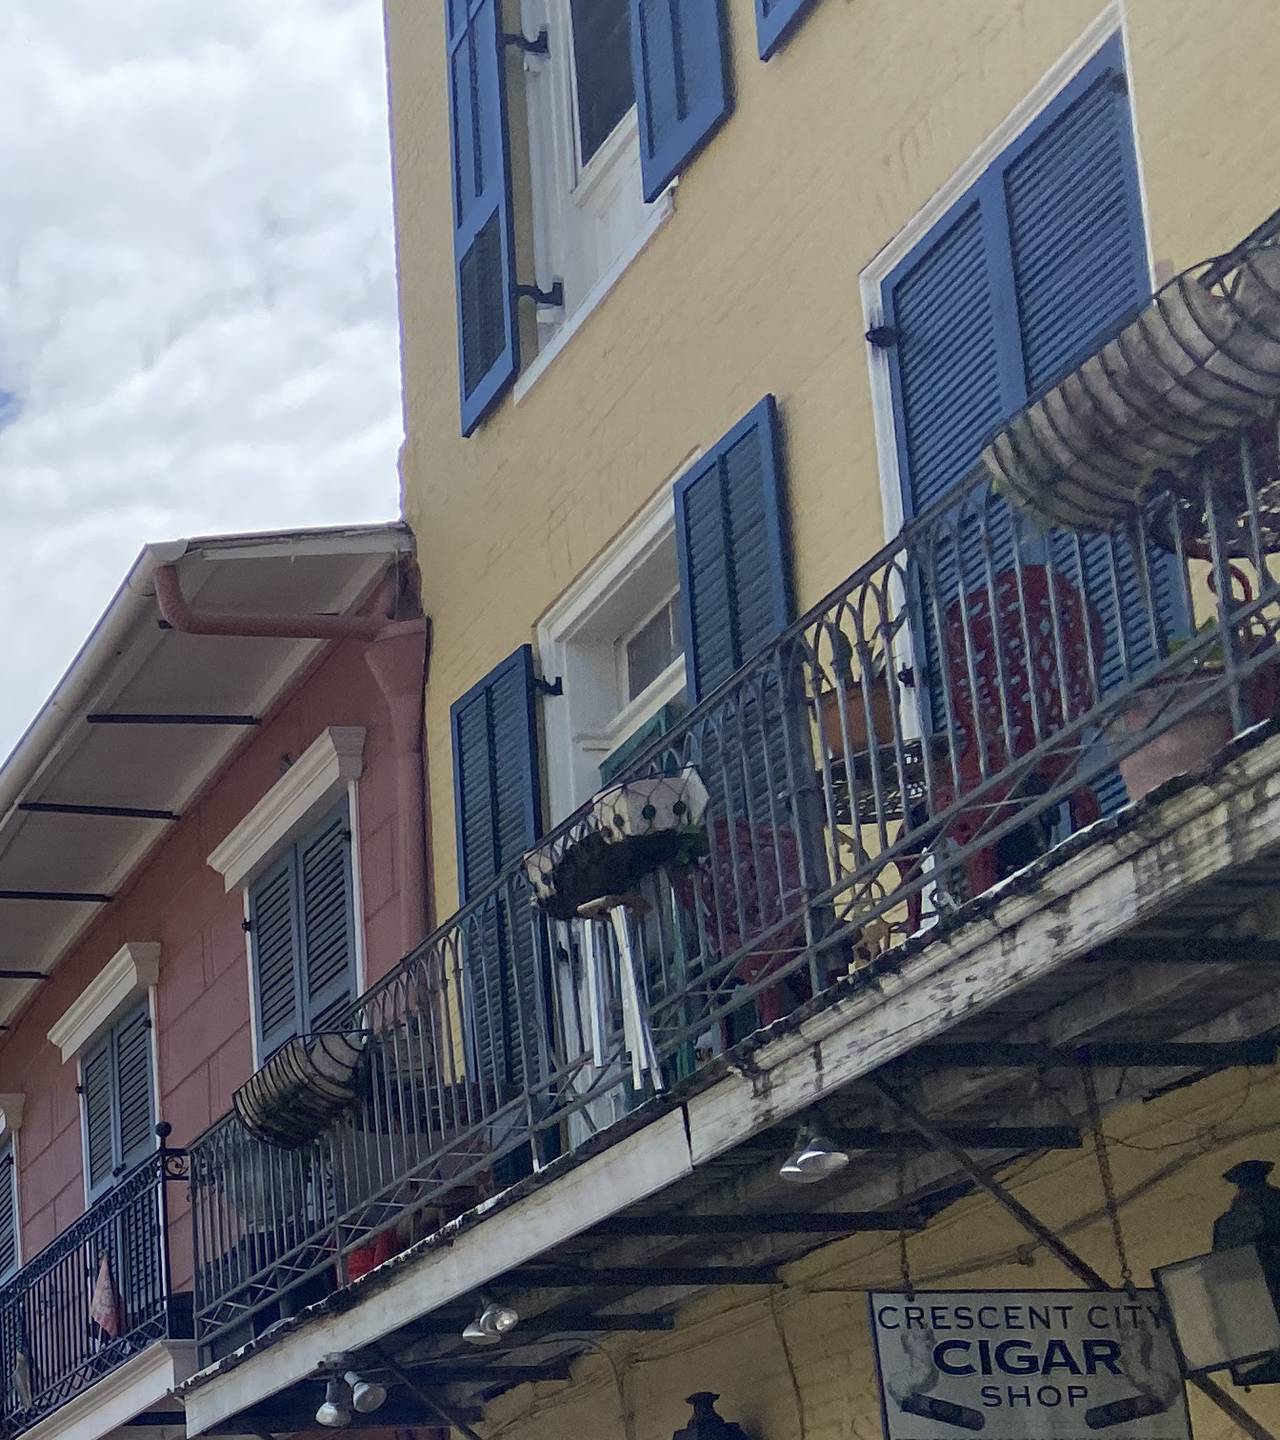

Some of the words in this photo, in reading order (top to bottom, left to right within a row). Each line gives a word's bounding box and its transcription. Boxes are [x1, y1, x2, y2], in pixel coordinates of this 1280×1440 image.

[878, 1306, 1073, 1329] CRESCENT
[1087, 1306, 1163, 1329] CITY
[933, 1339, 1123, 1376] CIGAR
[981, 1385, 1088, 1407] SHOP
